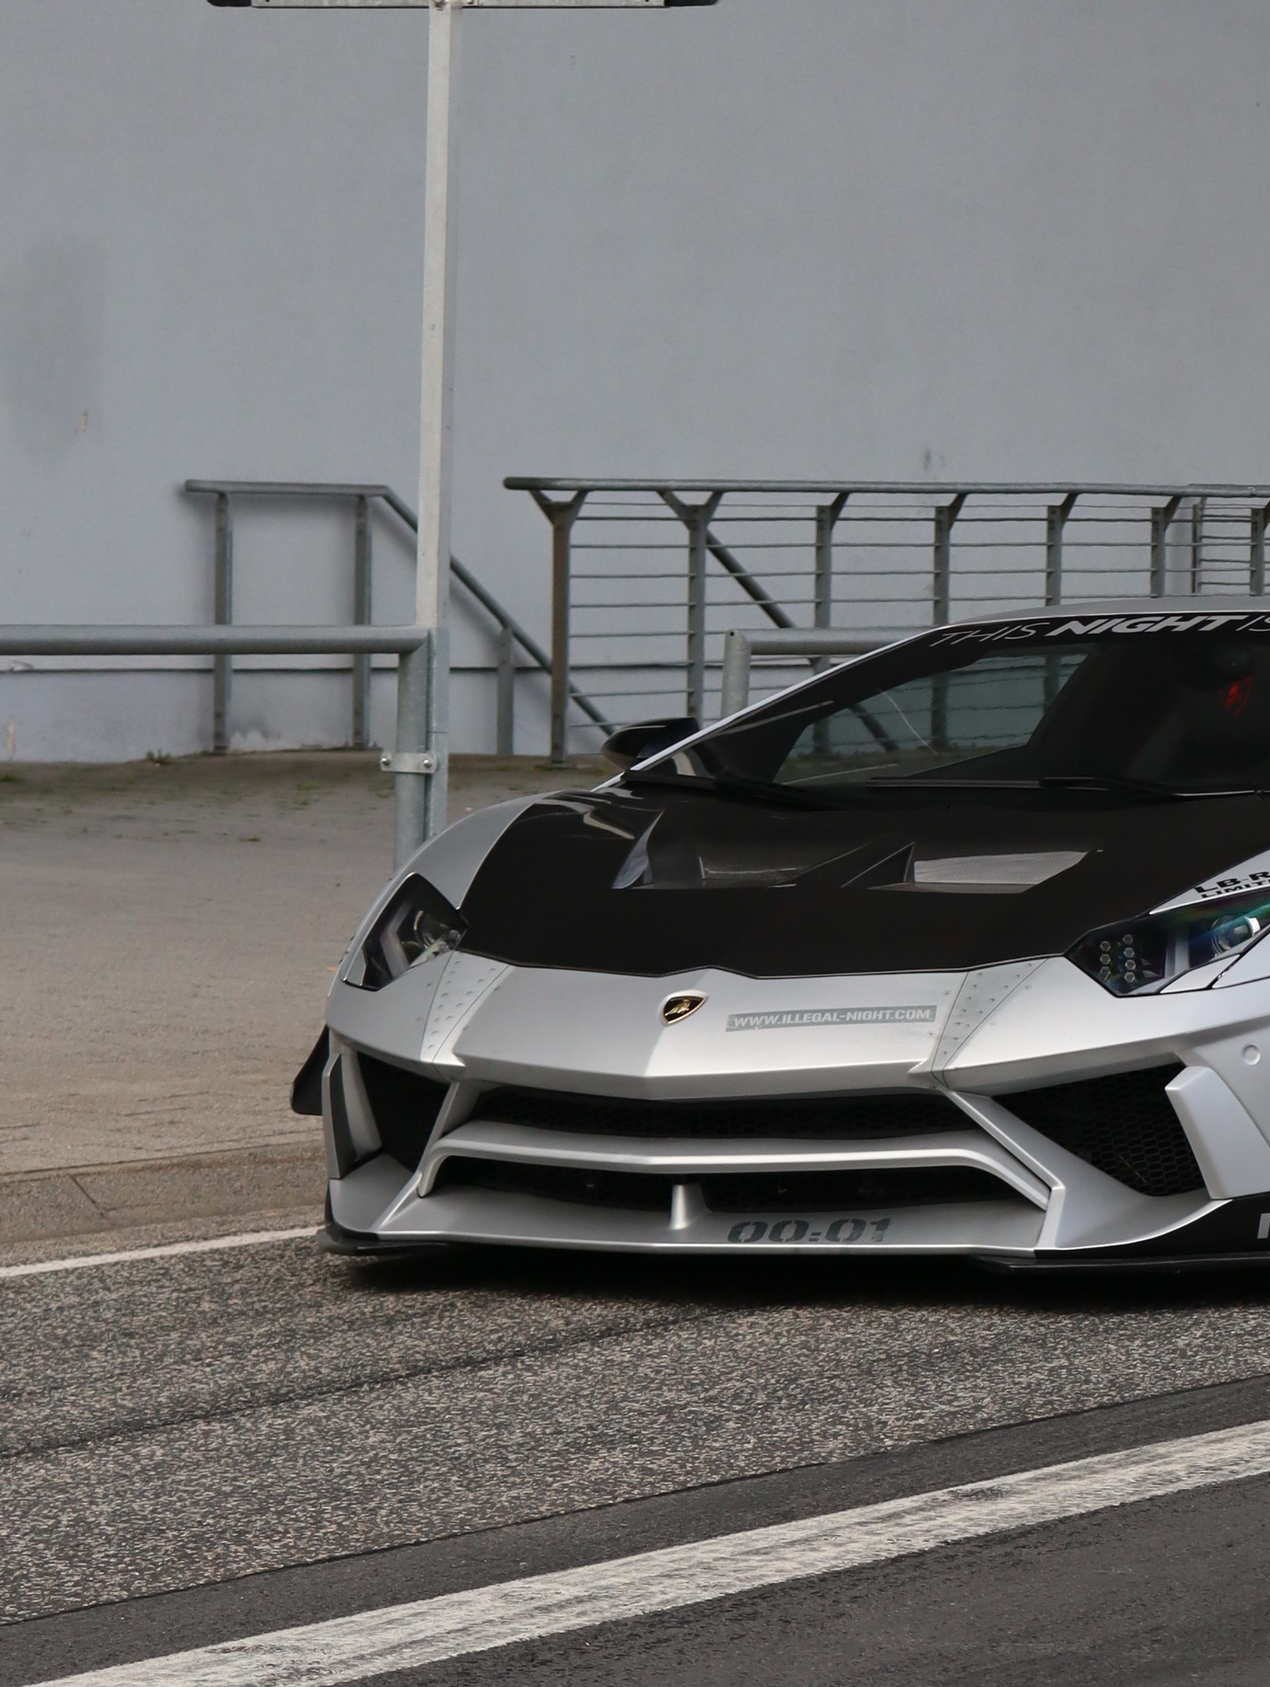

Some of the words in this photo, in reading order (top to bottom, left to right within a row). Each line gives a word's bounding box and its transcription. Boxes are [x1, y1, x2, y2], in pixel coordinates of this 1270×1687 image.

[929, 621, 1051, 647] THIS
[1047, 615, 1234, 637] NIGHT
[733, 1007, 931, 1028] WWW.ILLEGAL-NIGHT.COM
[727, 1218, 892, 1242] 00:01
